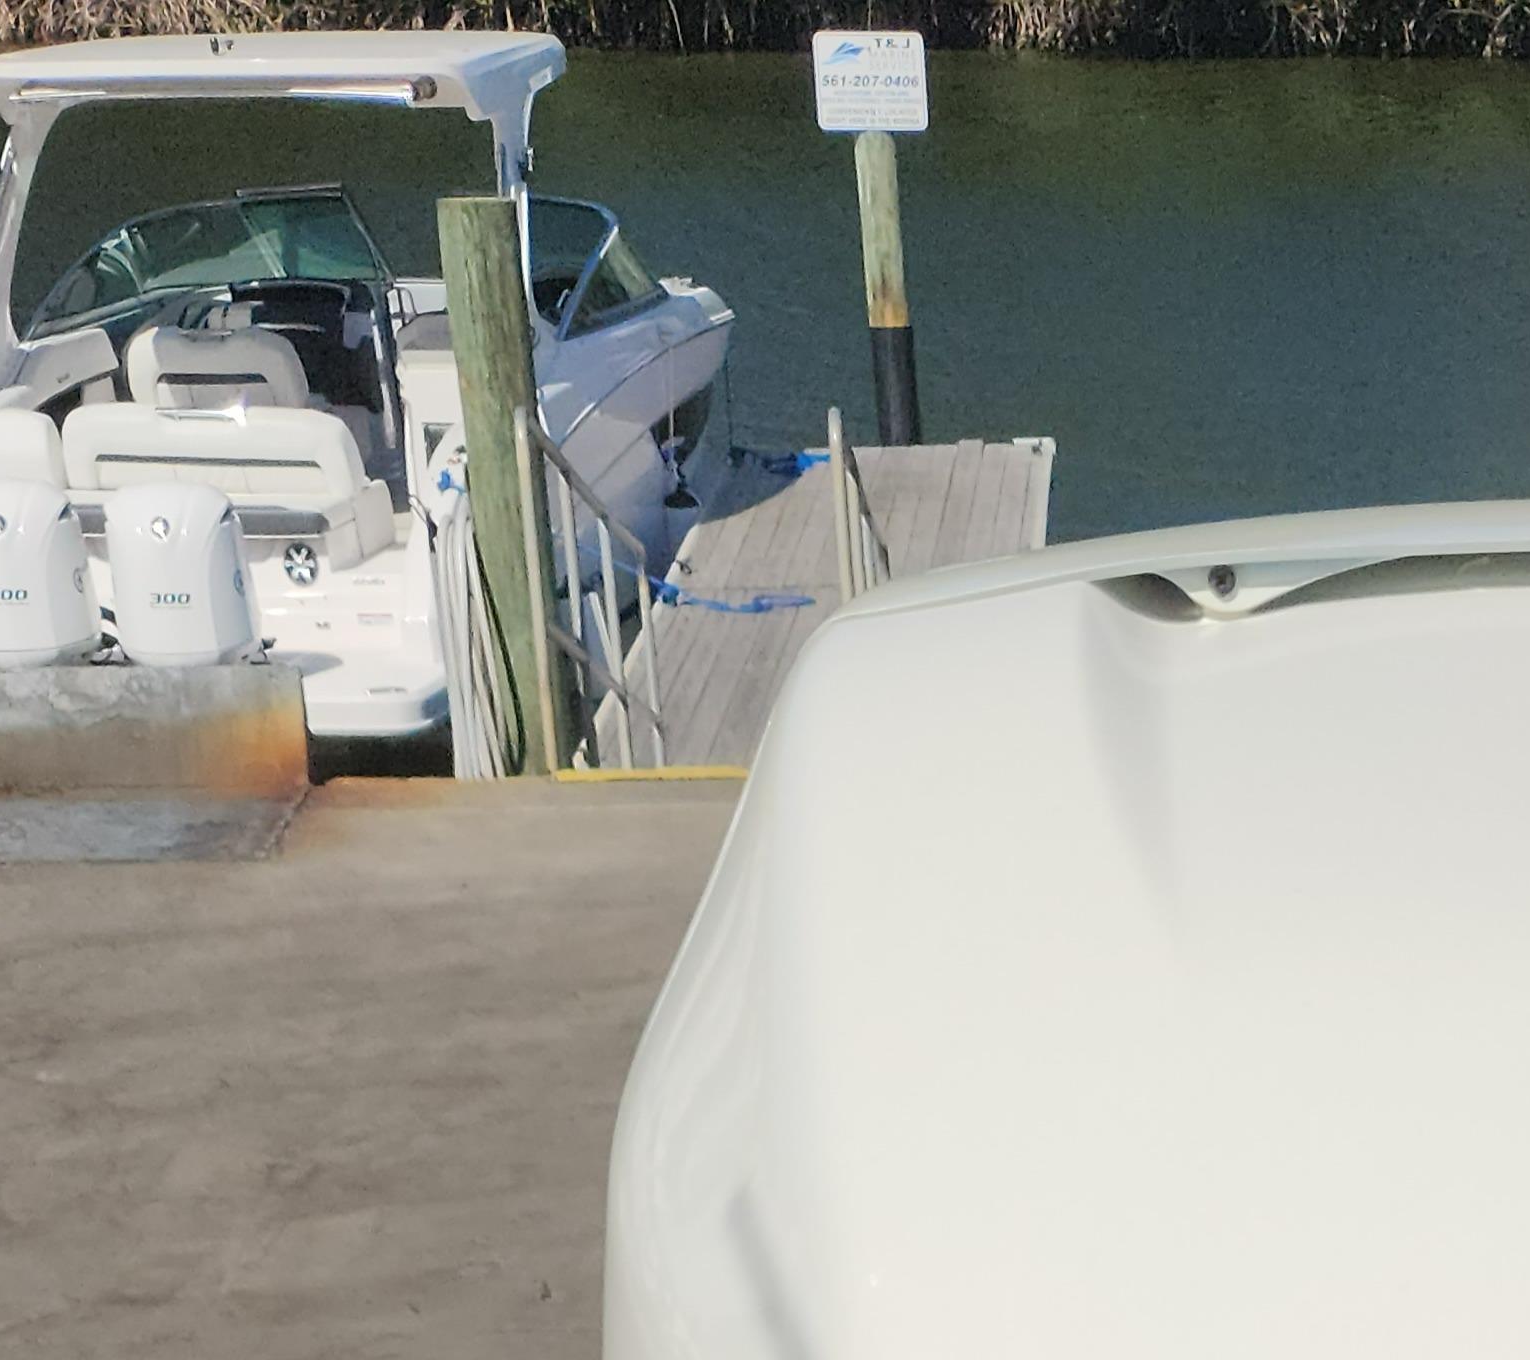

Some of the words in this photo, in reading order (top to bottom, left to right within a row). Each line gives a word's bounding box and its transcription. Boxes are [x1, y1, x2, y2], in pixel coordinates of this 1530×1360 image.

[874, 38, 882, 49] T
[886, 38, 898, 49] &
[901, 37, 910, 49] J
[821, 74, 919, 88] 561-207-0406
[150, 593, 191, 604] 300
